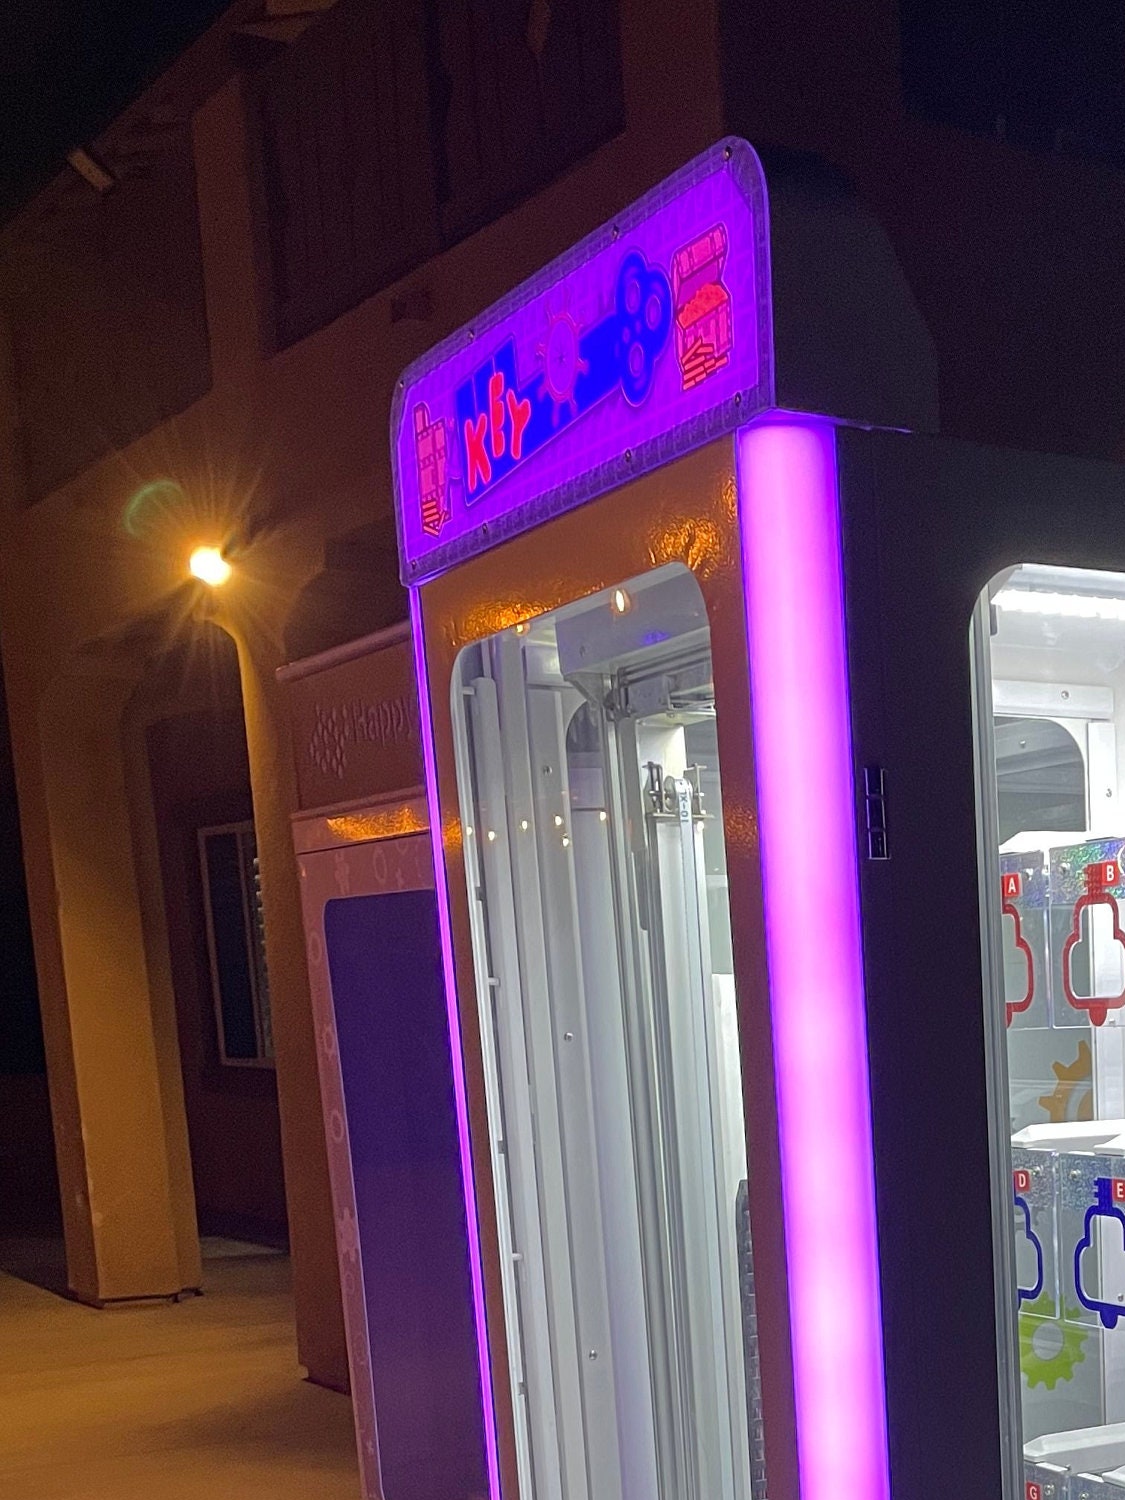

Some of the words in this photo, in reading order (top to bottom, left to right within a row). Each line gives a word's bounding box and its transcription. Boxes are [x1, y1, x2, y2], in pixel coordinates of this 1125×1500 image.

[464, 371, 531, 492] KEY
[1106, 865, 1115, 882] B
[1007, 880, 1017, 893] A
[1018, 1174, 1026, 1188] D
[1116, 1183, 1124, 1198] E
[1029, 1487, 1038, 1500] G
